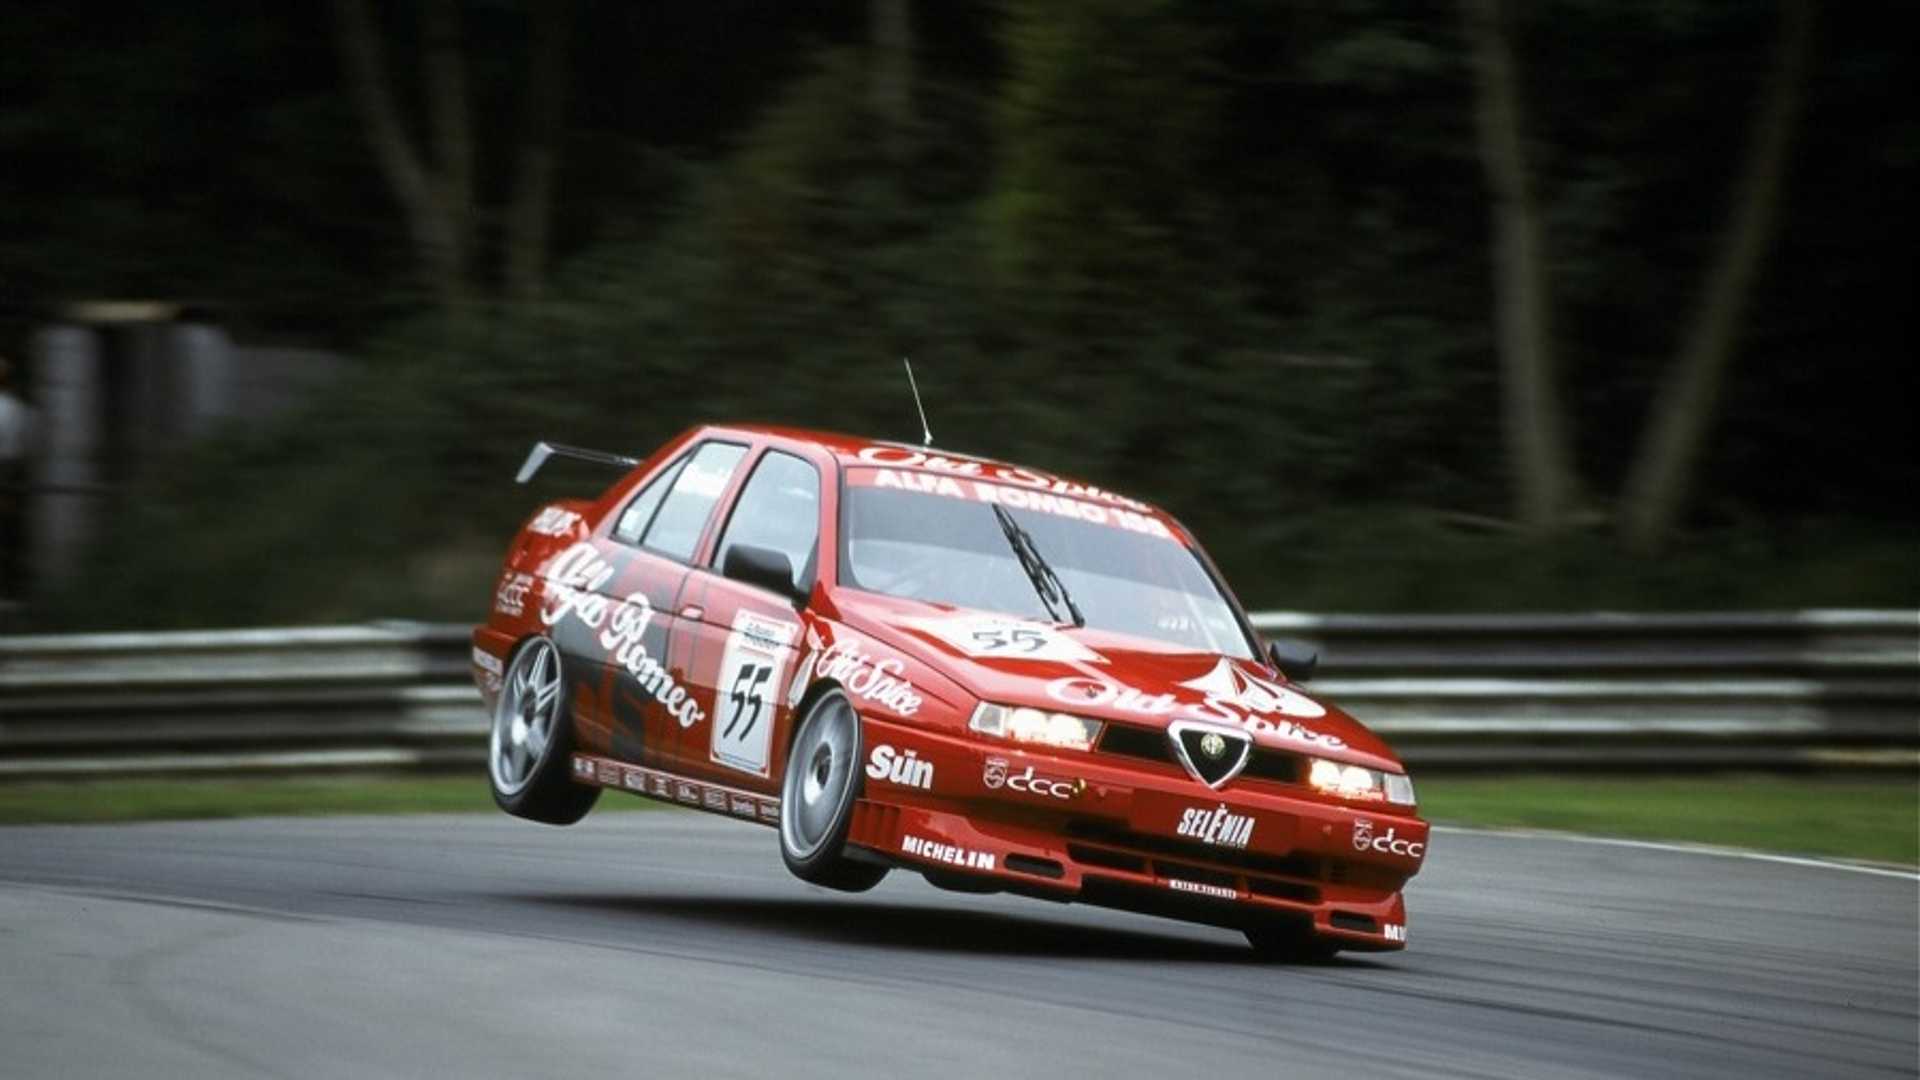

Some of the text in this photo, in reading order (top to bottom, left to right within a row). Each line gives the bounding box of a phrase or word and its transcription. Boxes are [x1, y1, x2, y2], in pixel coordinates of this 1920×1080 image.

[873, 470, 965, 499] ALFA
[974, 483, 1108, 524] ROMEO
[541, 543, 705, 728] Alfa Romeo
[972, 630, 1048, 652] 55
[722, 663, 773, 742] 55
[817, 639, 922, 716] Old Spice
[1045, 677, 1349, 750] Old Spice
[1007, 766, 1074, 799] dcc
[902, 835, 995, 870] MICHELIN
[1372, 828, 1424, 858] dcc
